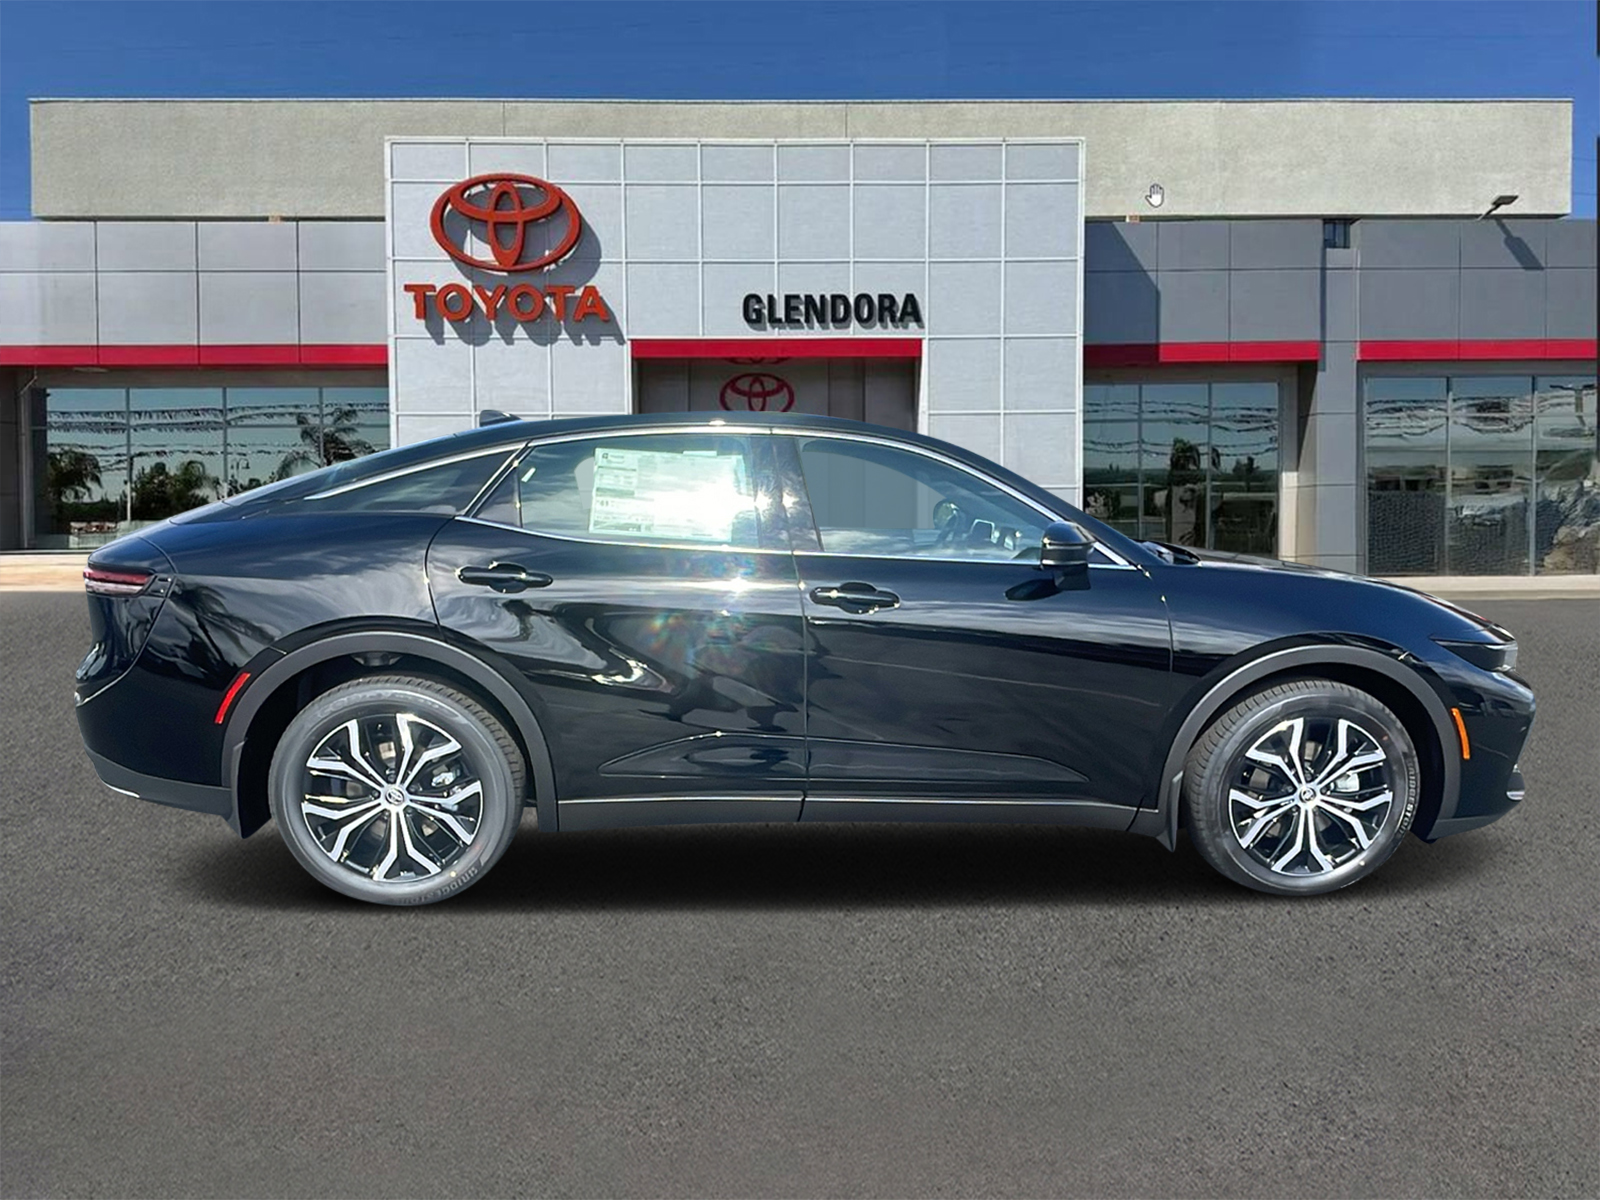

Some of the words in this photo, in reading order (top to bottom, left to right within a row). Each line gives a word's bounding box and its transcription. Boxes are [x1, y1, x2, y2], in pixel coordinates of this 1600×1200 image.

[404, 283, 611, 323] TOYOTA
[742, 293, 923, 324] GLENDORA
[1397, 760, 1417, 837] BRIDGESTON
[396, 865, 478, 905] BRIDGESTON
